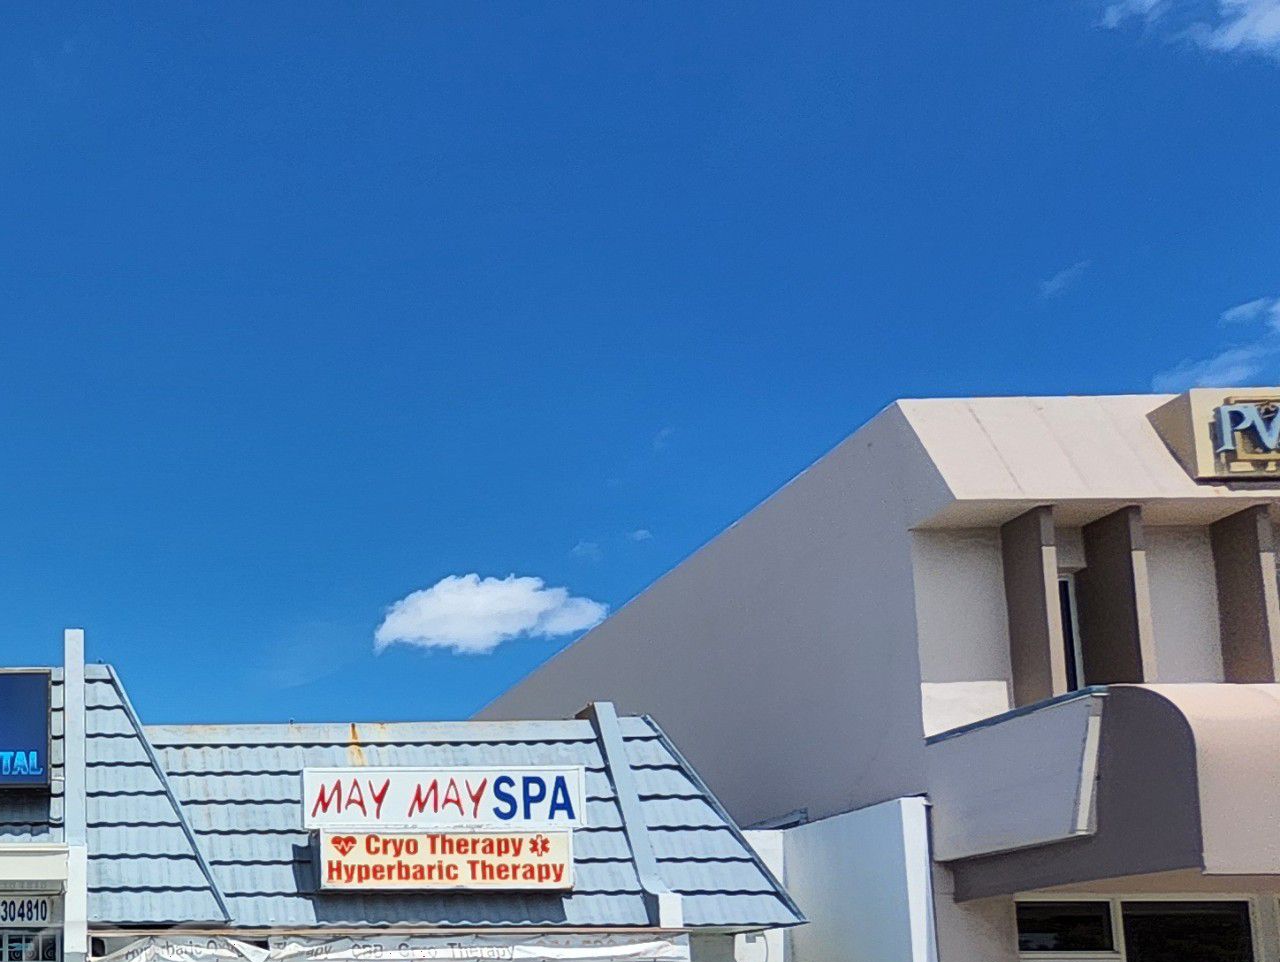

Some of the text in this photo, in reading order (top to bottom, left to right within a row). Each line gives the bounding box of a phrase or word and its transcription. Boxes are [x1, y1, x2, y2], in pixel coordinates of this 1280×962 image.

[312, 775, 576, 820] MAY MAY SPA
[365, 834, 523, 858] Cryo Therapy
[327, 860, 565, 883] Hyperbaric Therapy
[446, 942, 514, 960] Therapy
